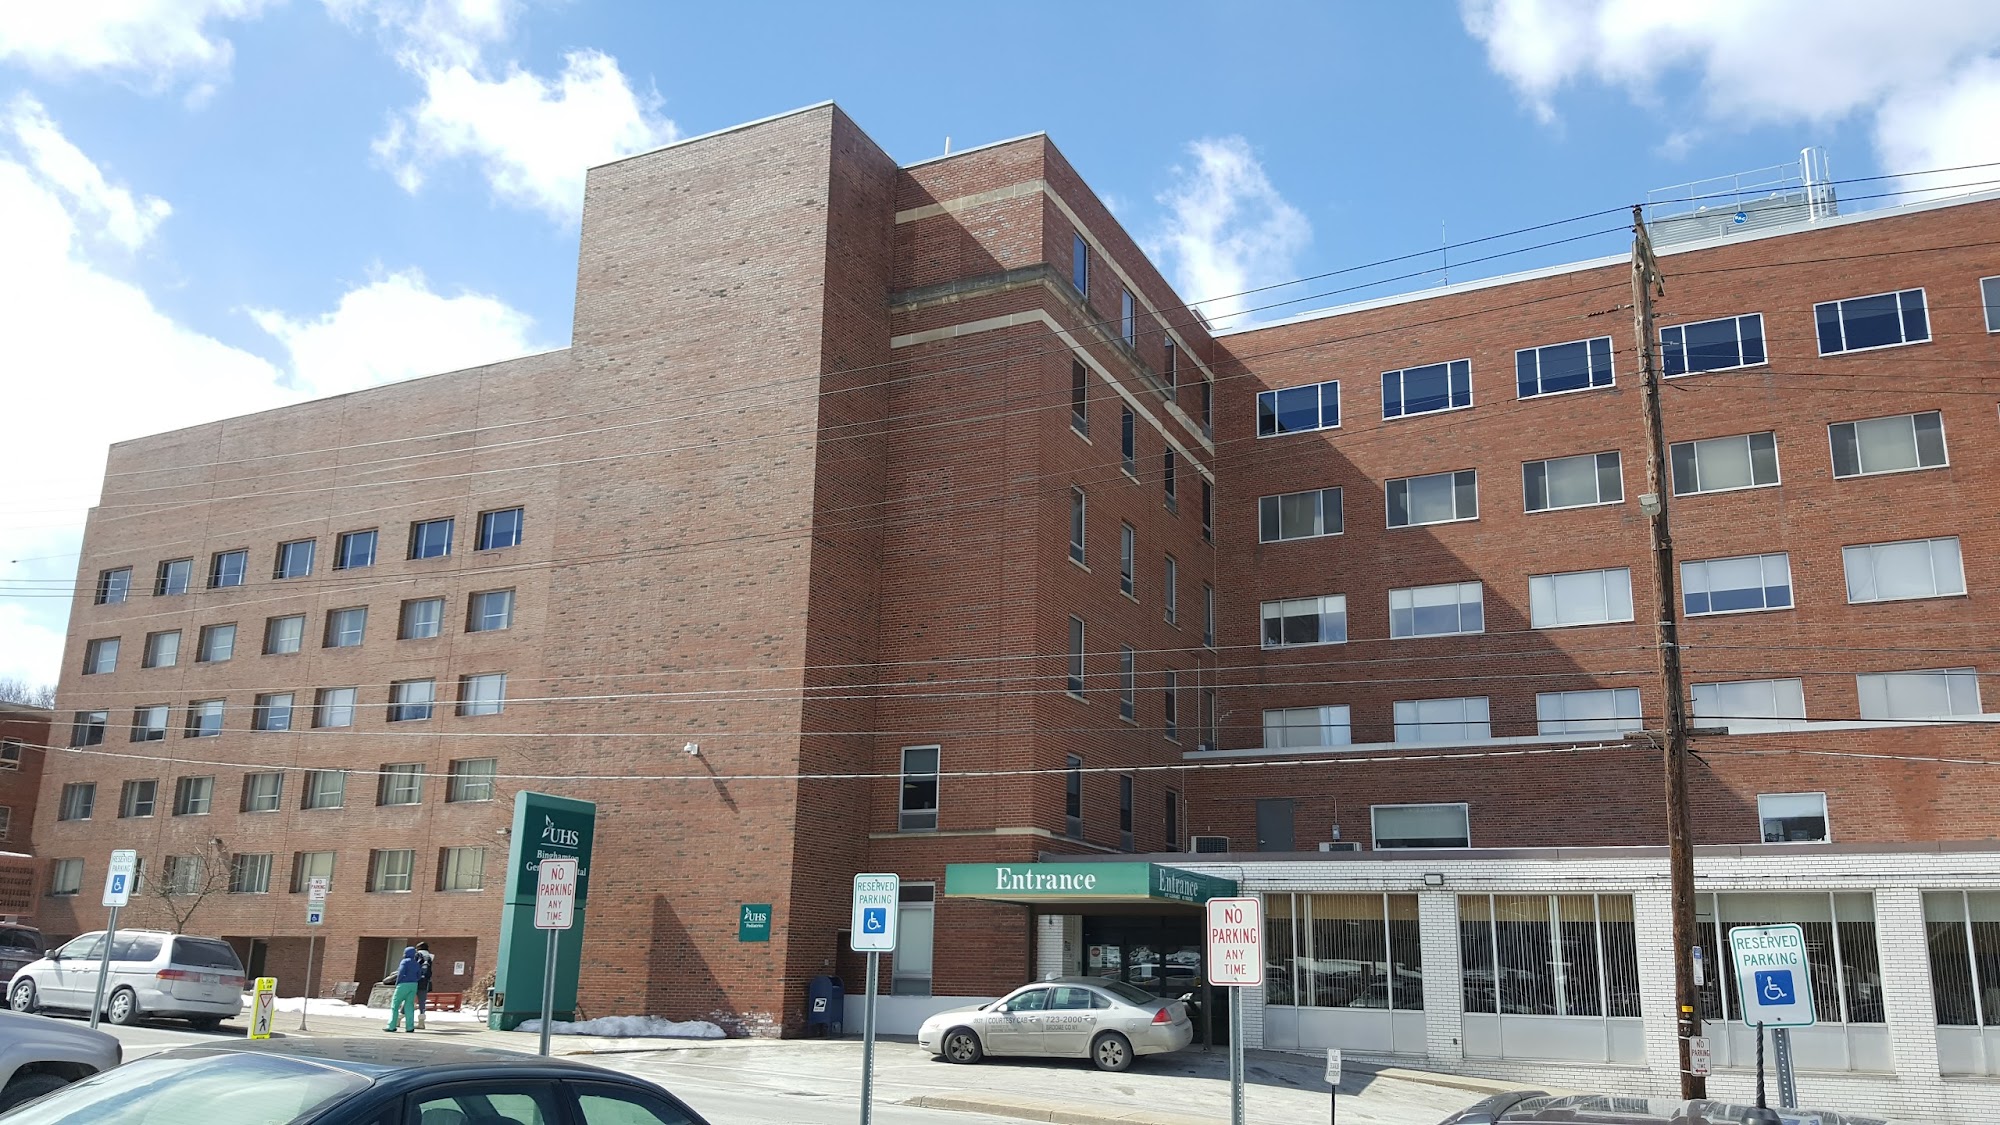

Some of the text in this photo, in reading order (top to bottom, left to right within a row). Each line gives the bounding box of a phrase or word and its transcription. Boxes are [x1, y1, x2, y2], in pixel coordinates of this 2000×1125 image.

[550, 829, 579, 845] UHS
[551, 867, 564, 881] NO
[995, 867, 1096, 890] Entrance
[857, 882, 895, 892] RESERVED
[1158, 868, 1199, 897] Entrance
[540, 883, 572, 897] PARKING
[548, 900, 562, 909] ANY
[859, 894, 892, 904] PARKING
[546, 911, 562, 921] TIME
[749, 912, 767, 922] UHS
[1224, 908, 1243, 924] NO
[1212, 927, 1257, 944] PARKING
[1736, 935, 1798, 950] RESERVED
[1225, 949, 1245, 960] ANY
[1743, 952, 1798, 967] PARKING
[1224, 963, 1247, 975] TIME
[987, 1016, 1016, 1024] COURTESY
[1016, 1016, 1028, 1024] CAB
[1045, 1015, 1083, 1023] 723-2000
[1696, 1040, 1705, 1048] NO
